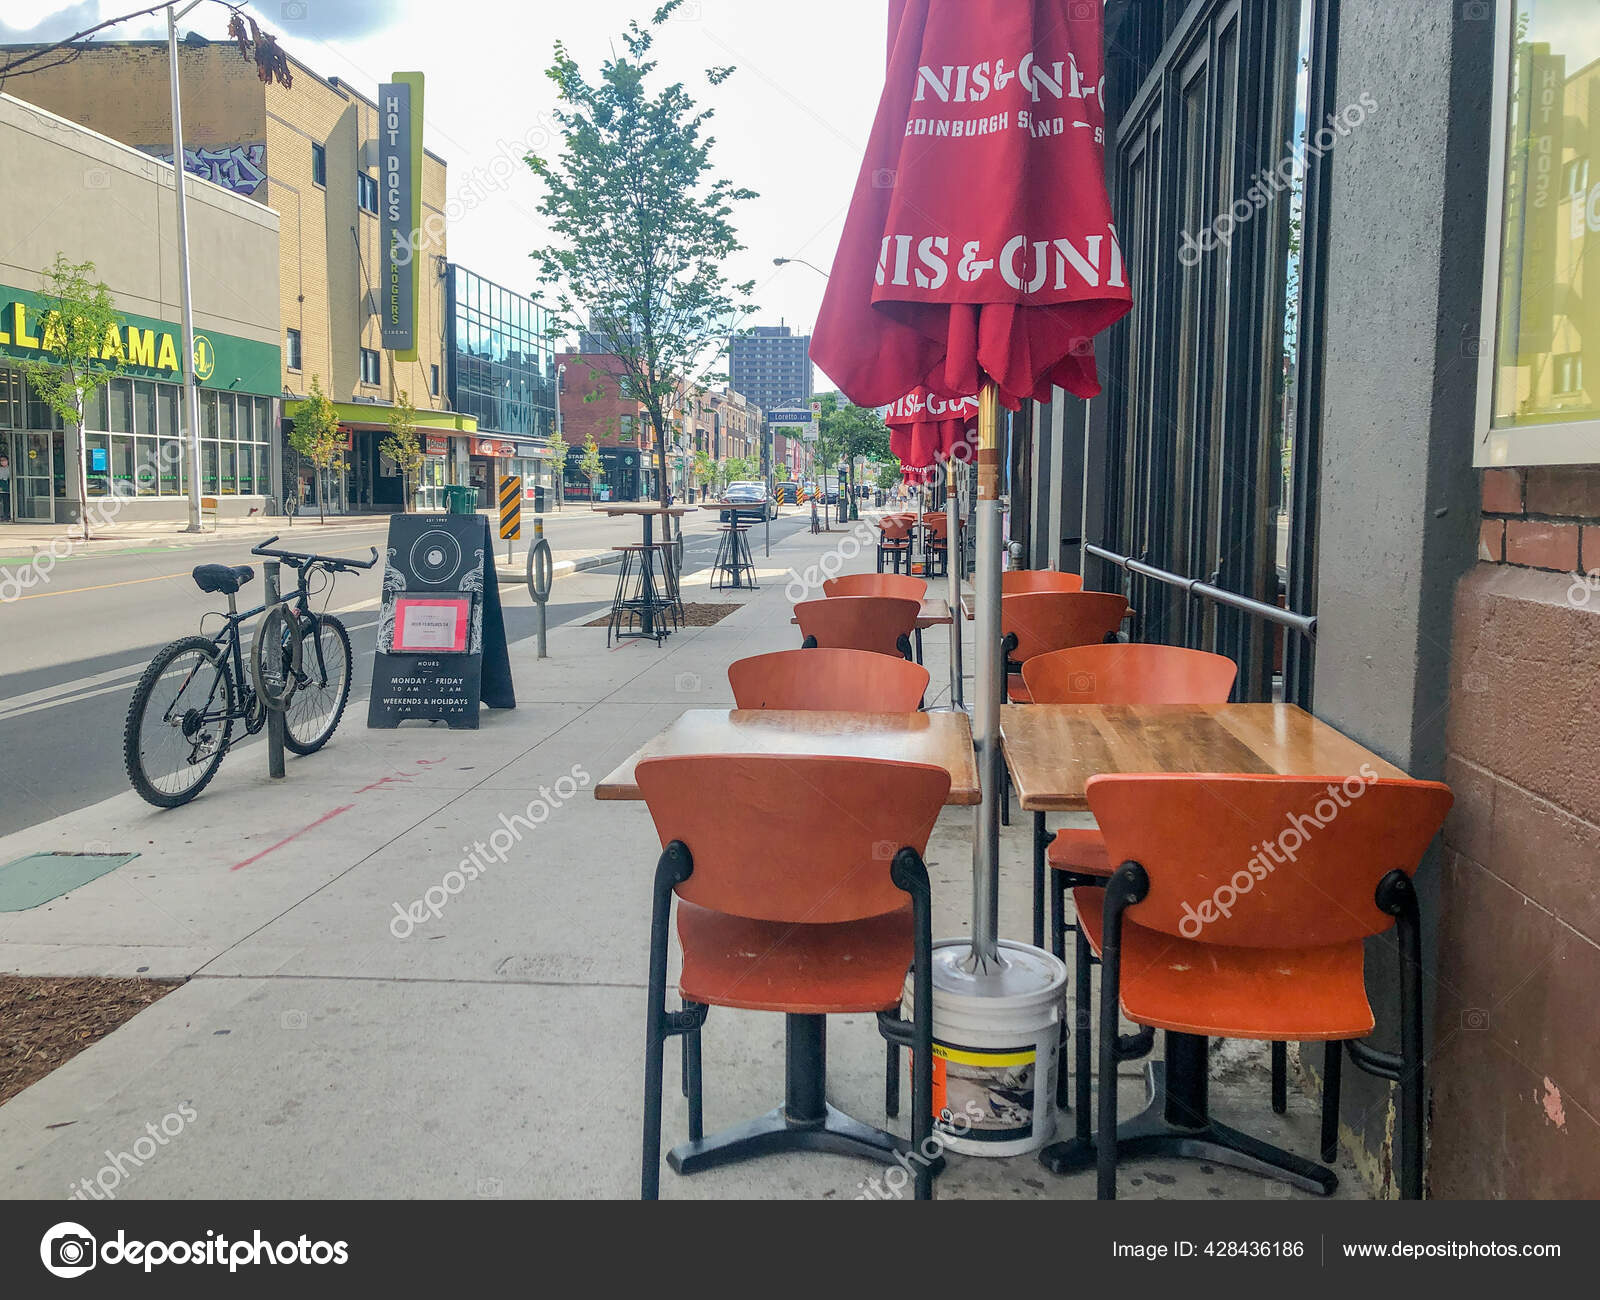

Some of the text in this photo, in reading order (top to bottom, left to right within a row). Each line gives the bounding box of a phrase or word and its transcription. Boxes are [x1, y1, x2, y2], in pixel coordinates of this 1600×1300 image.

[386, 97, 399, 146] HOT
[905, 112, 1008, 137] EDINBURGH
[387, 156, 400, 221] DOCS
[391, 264, 399, 324] ROGERS
[0, 302, 178, 372] LAAMA
[775, 413, 798, 421] Loretto
[391, 677, 427, 685] MONDAY
